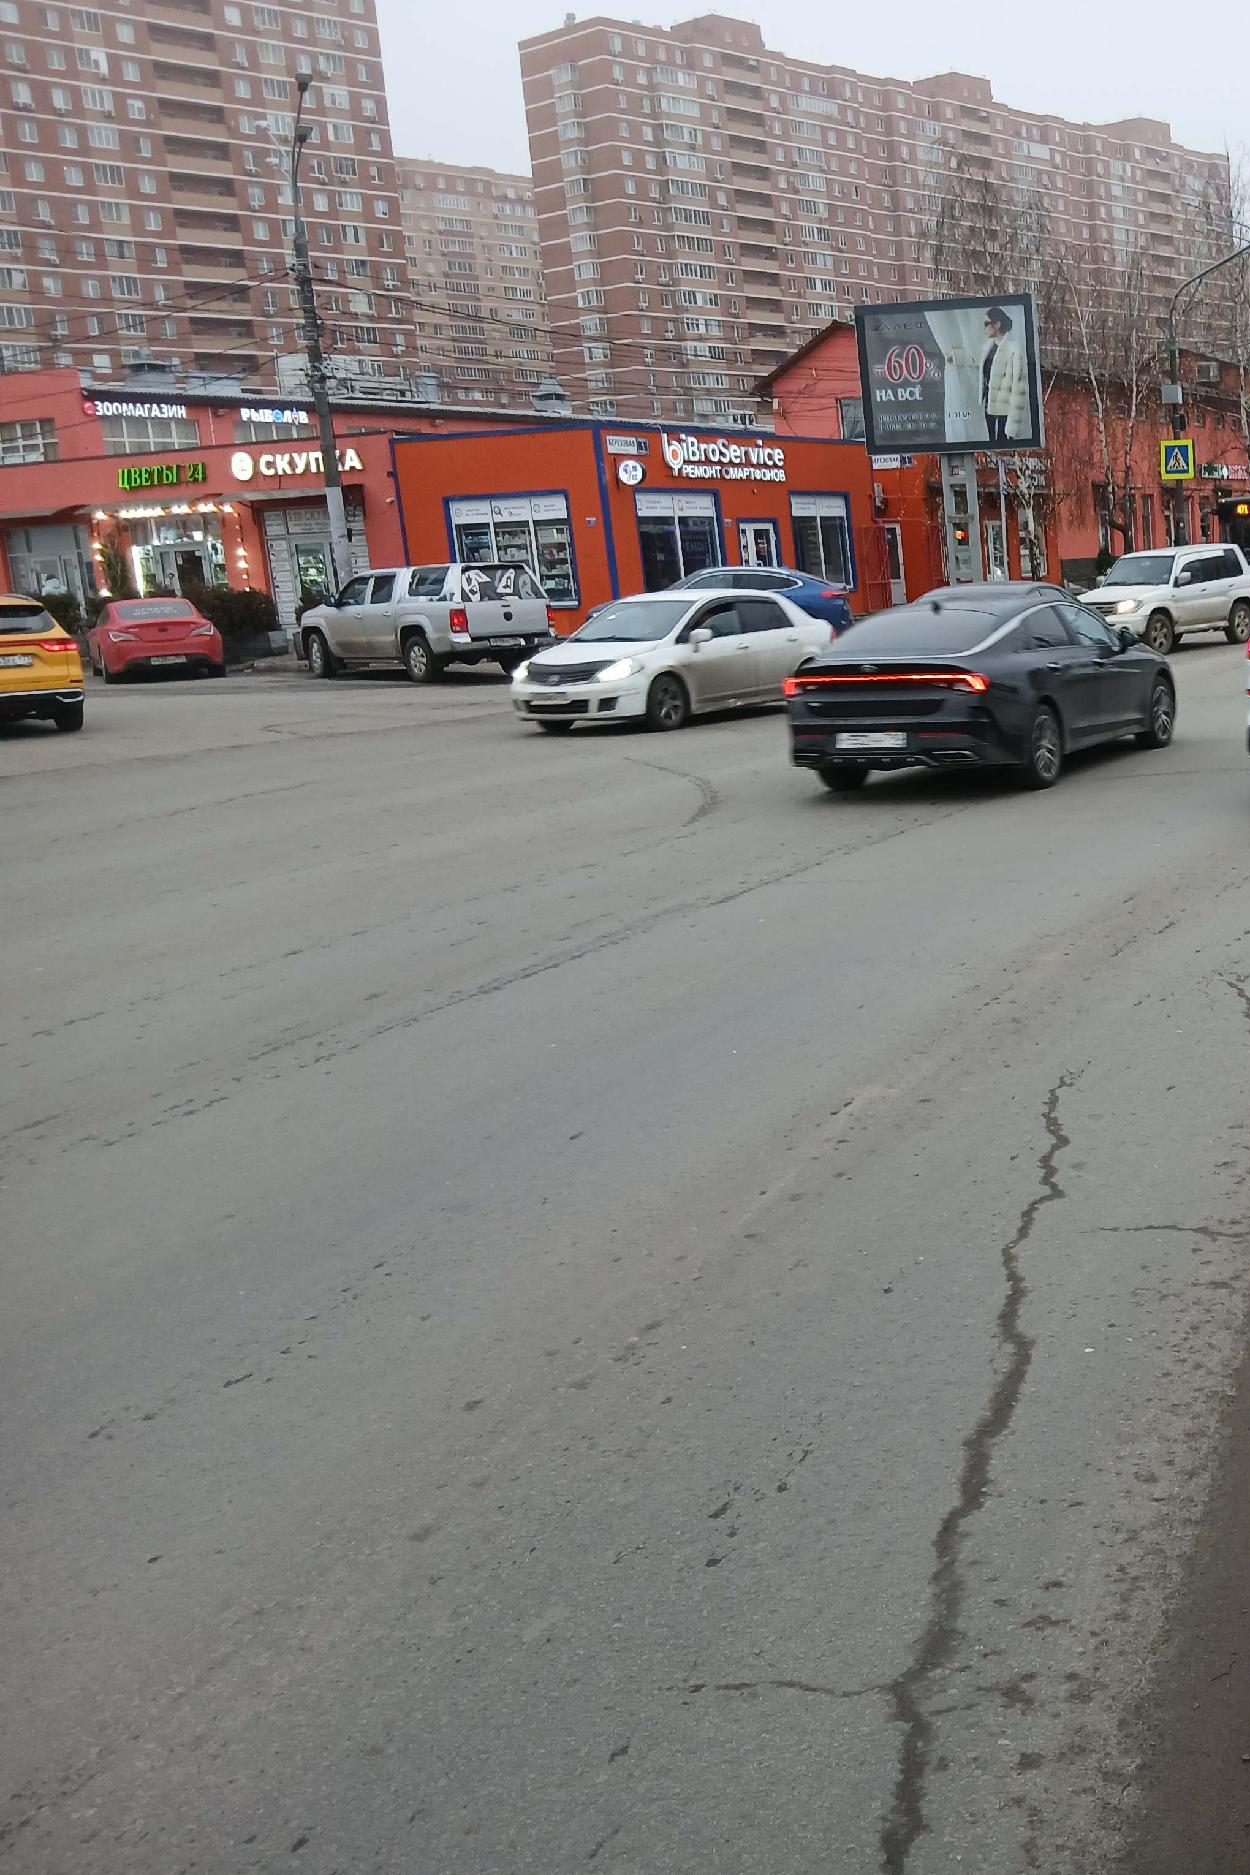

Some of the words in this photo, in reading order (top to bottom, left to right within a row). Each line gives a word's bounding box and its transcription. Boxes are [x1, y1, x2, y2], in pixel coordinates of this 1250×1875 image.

[876, 389, 894, 402] НА
[898, 384, 923, 400] ВСЁ
[95, 401, 187, 418] ЗООМАГАЗИН
[259, 447, 364, 476] СКУПА
[117, 464, 179, 490] ЦВЕТЫ
[186, 462, 205, 482] 24
[683, 465, 722, 479] РЕМОНТ
[722, 468, 786, 482] СМАРТФОНОВ
